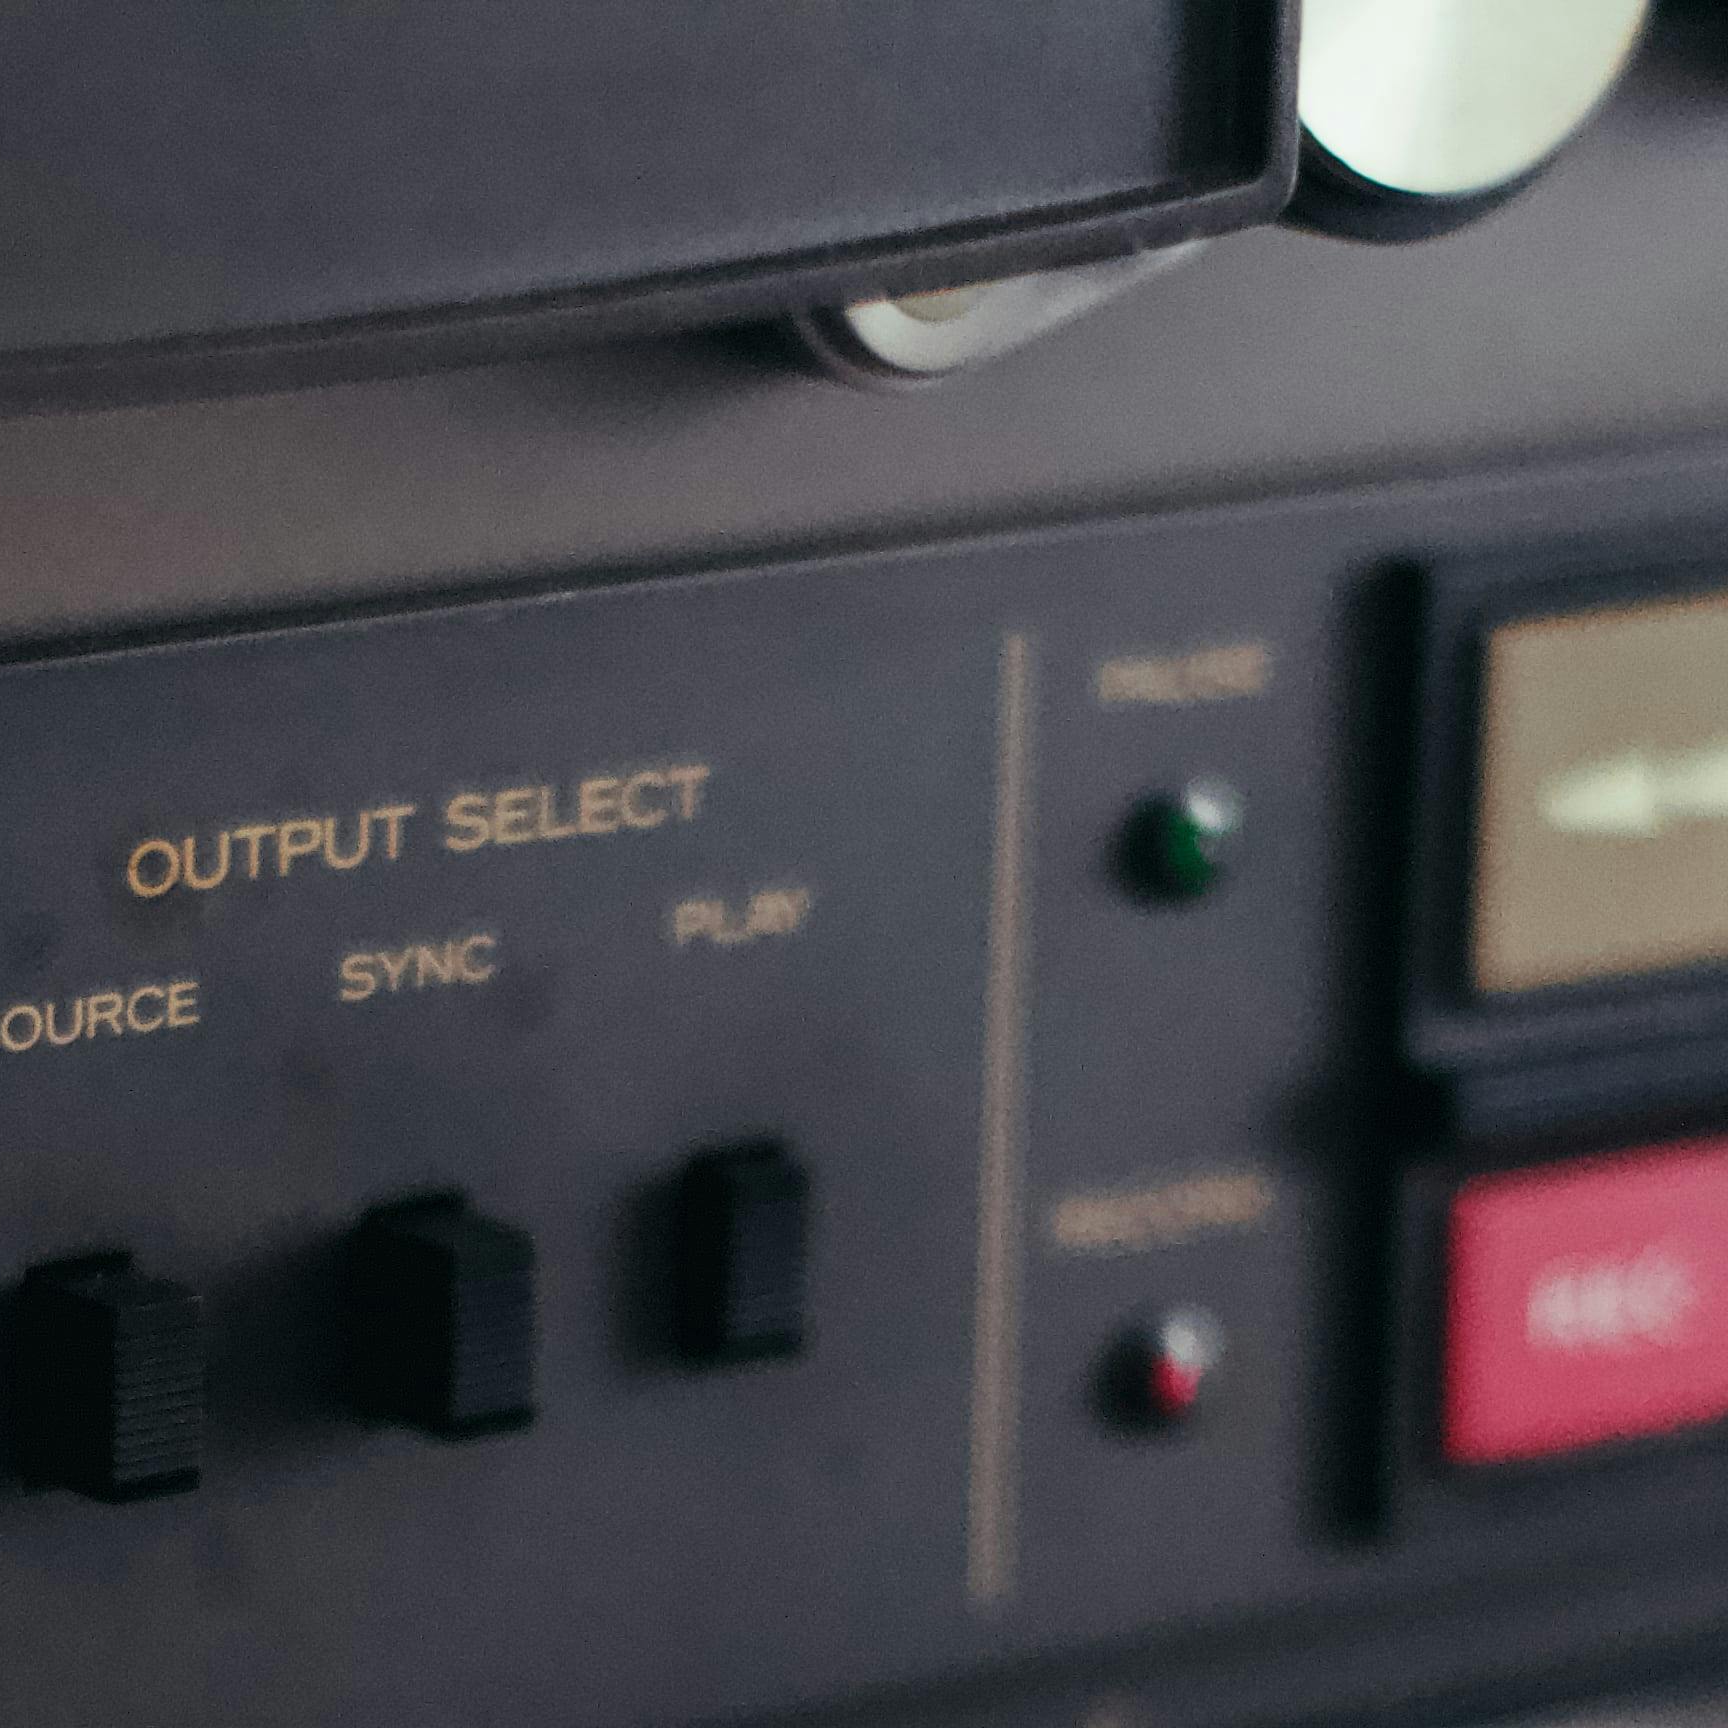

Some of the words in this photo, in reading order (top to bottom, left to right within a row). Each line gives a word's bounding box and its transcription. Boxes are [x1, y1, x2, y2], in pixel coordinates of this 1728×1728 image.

[127, 805, 414, 897] OUTPUT
[445, 765, 708, 851] SELECT
[674, 890, 806, 943] PLAY
[340, 934, 494, 1001] SYNC
